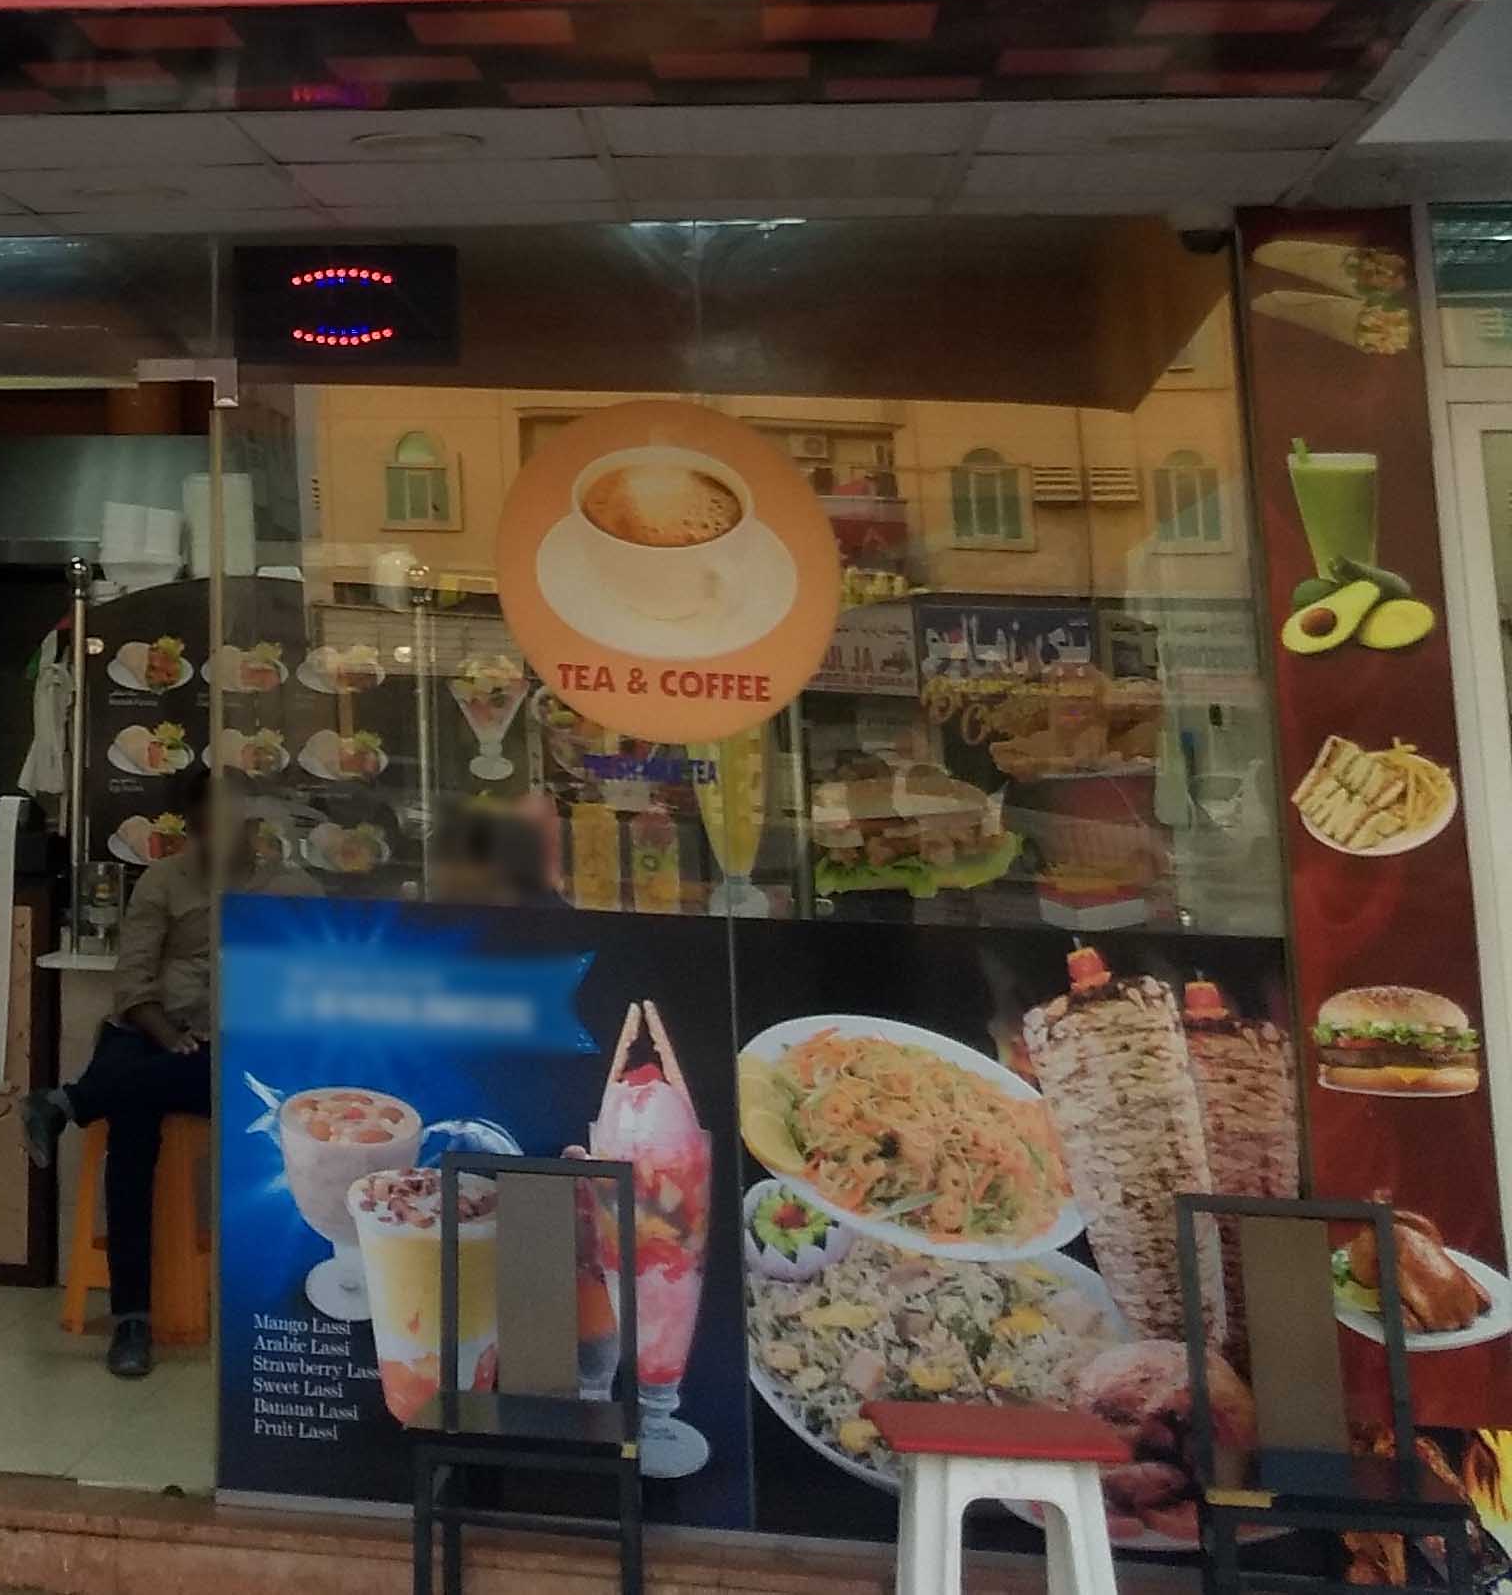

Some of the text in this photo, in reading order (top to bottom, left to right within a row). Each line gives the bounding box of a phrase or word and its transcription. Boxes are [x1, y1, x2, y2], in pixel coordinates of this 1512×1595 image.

[556, 662, 772, 703] TEA & COFFEE
[253, 1313, 351, 1335] Mango Lassi
[253, 1335, 350, 1356] Arabic Lassi
[252, 1355, 381, 1381] Strawberry Lass
[252, 1377, 343, 1398] Sweet Lassi
[254, 1398, 359, 1421] Banana Lassi
[254, 1418, 338, 1440] Fruit Lassi
